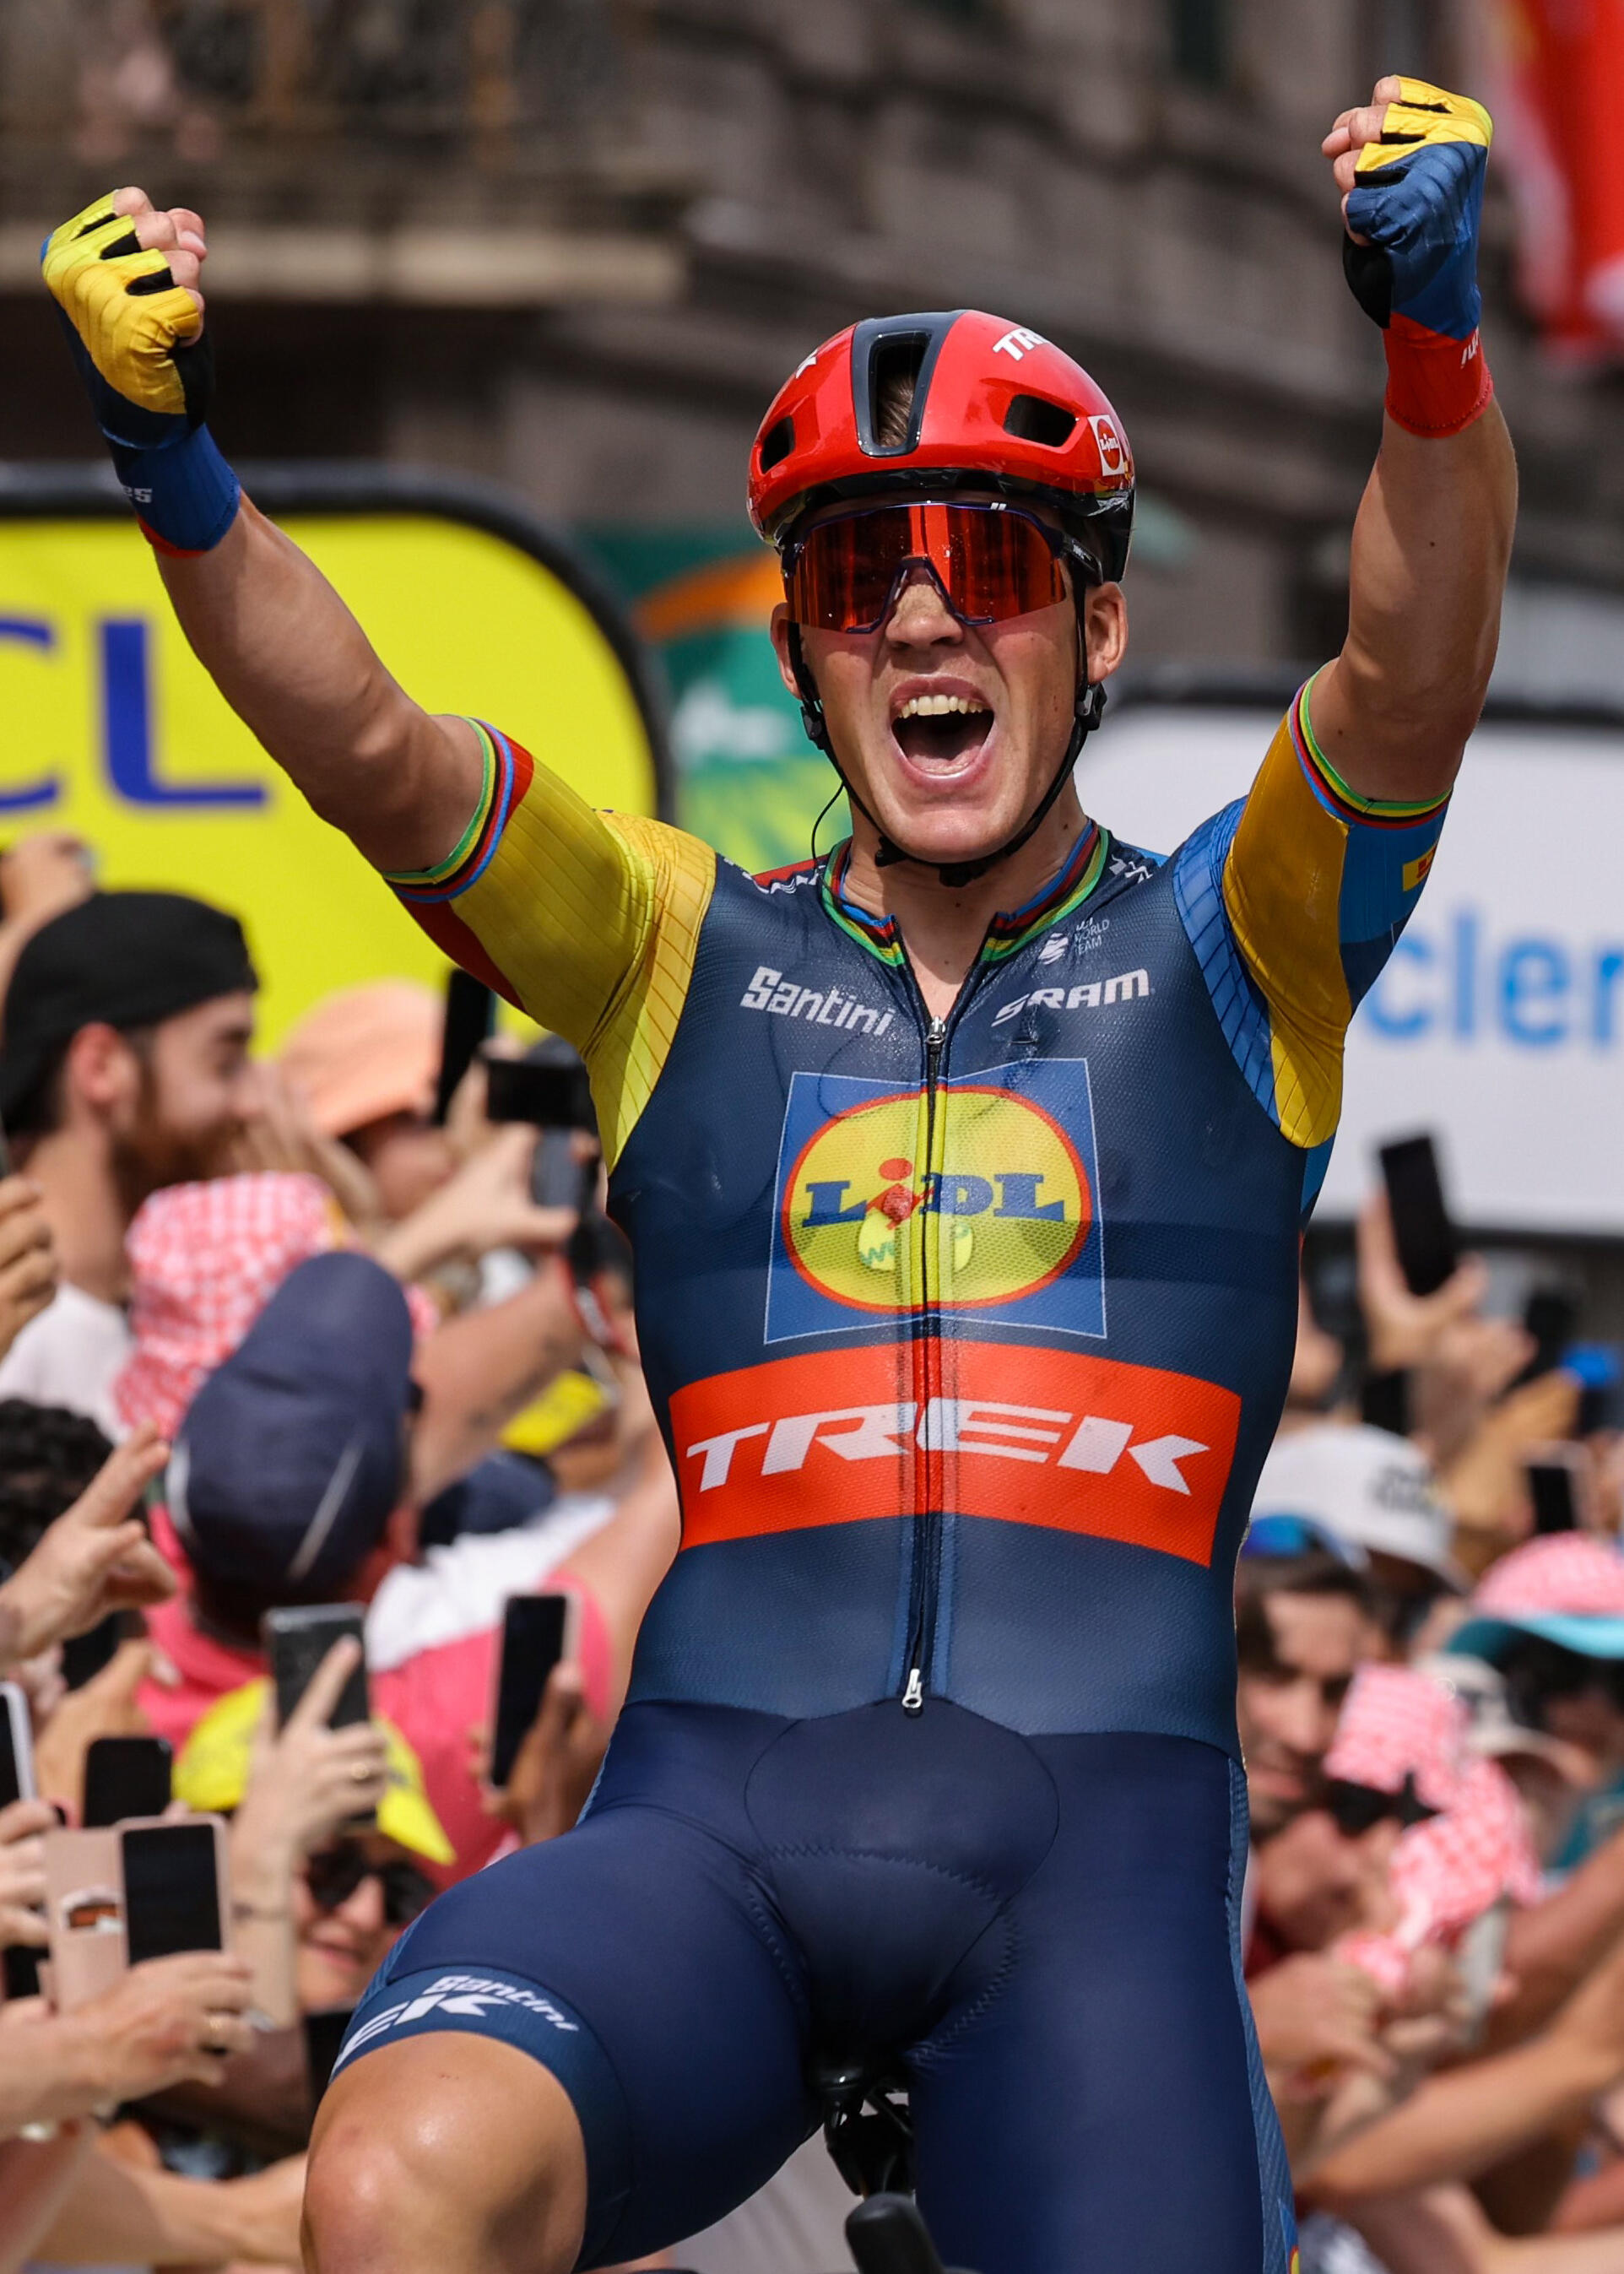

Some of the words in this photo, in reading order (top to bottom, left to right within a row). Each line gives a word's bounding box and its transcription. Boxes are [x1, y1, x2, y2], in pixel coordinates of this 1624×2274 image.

[739, 966, 896, 1036] Santini
[991, 968, 1150, 1027] SRAM
[686, 1396, 1210, 1497] TREK
[423, 1974, 580, 2032] Santini
